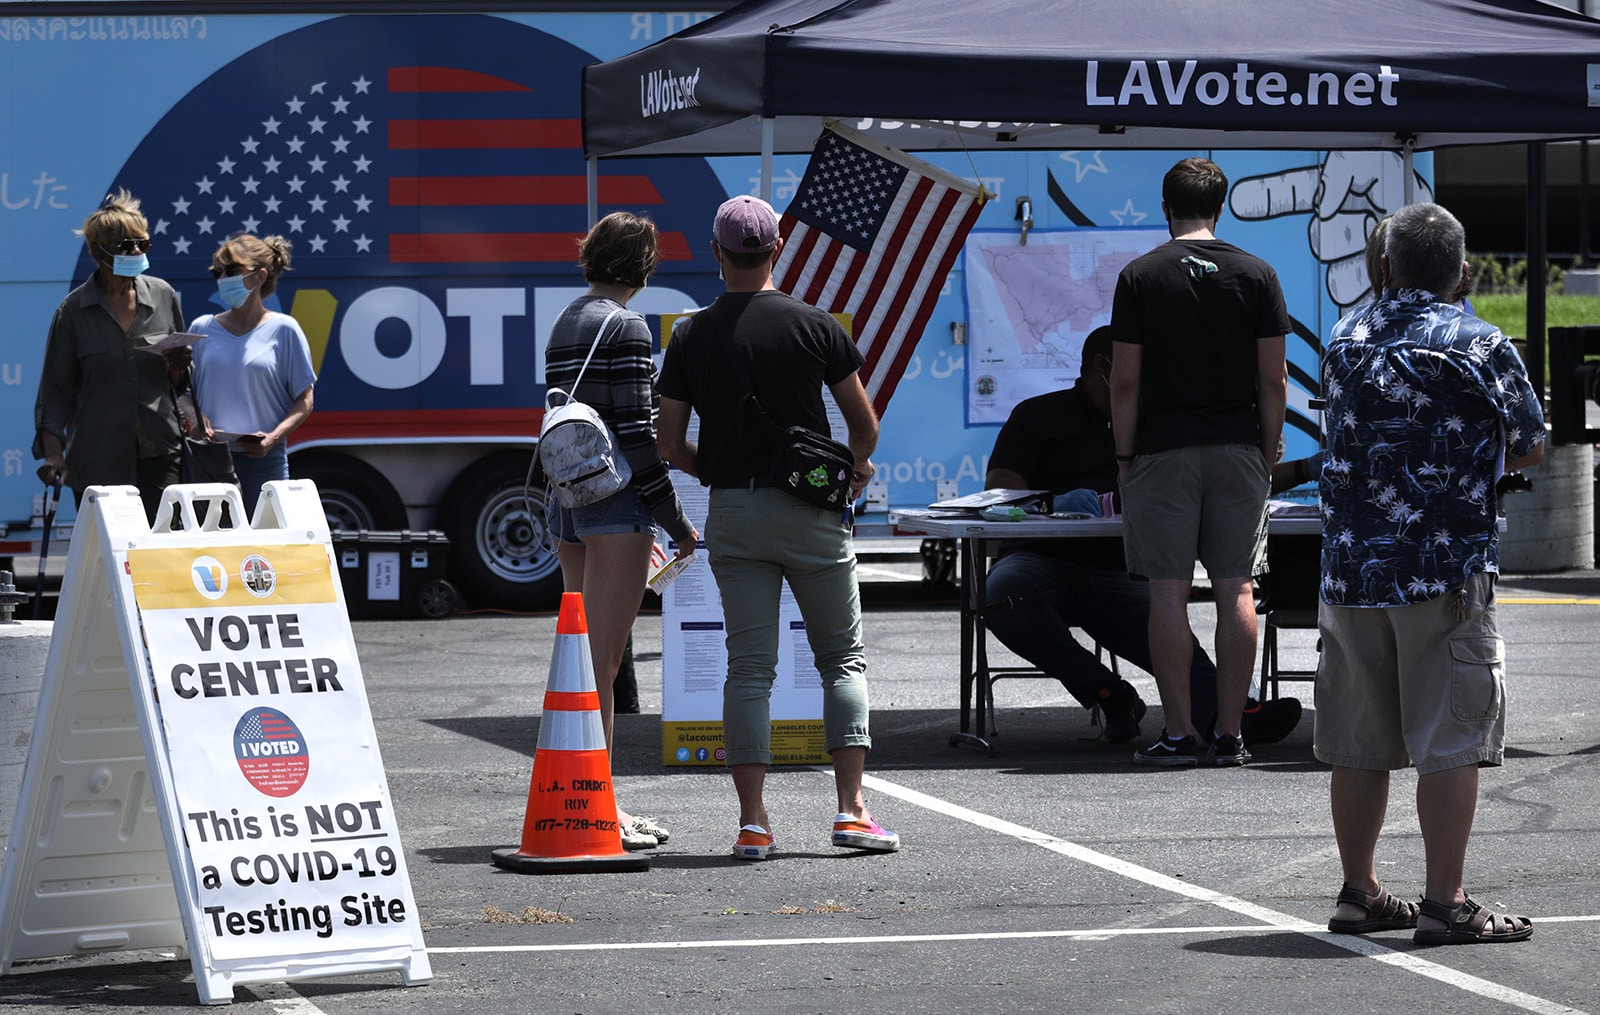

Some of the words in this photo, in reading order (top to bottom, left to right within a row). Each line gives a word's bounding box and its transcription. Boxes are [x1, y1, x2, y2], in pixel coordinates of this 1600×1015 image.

[641, 67, 701, 117] LAVotenet
[1085, 60, 1399, 106] LAVote.net
[185, 614, 304, 652] VOTE
[170, 658, 344, 700] CENTER
[241, 743, 248, 757] I
[248, 740, 300, 757] VOTED
[678, 733, 725, 743] @lacounty
[188, 808, 263, 842] This
[267, 806, 299, 837] is
[304, 801, 383, 835] NOT
[565, 799, 589, 810] ROV
[201, 865, 223, 889] a
[230, 846, 397, 887] COVID-19
[204, 899, 333, 938] Testing
[340, 893, 405, 926] Site
